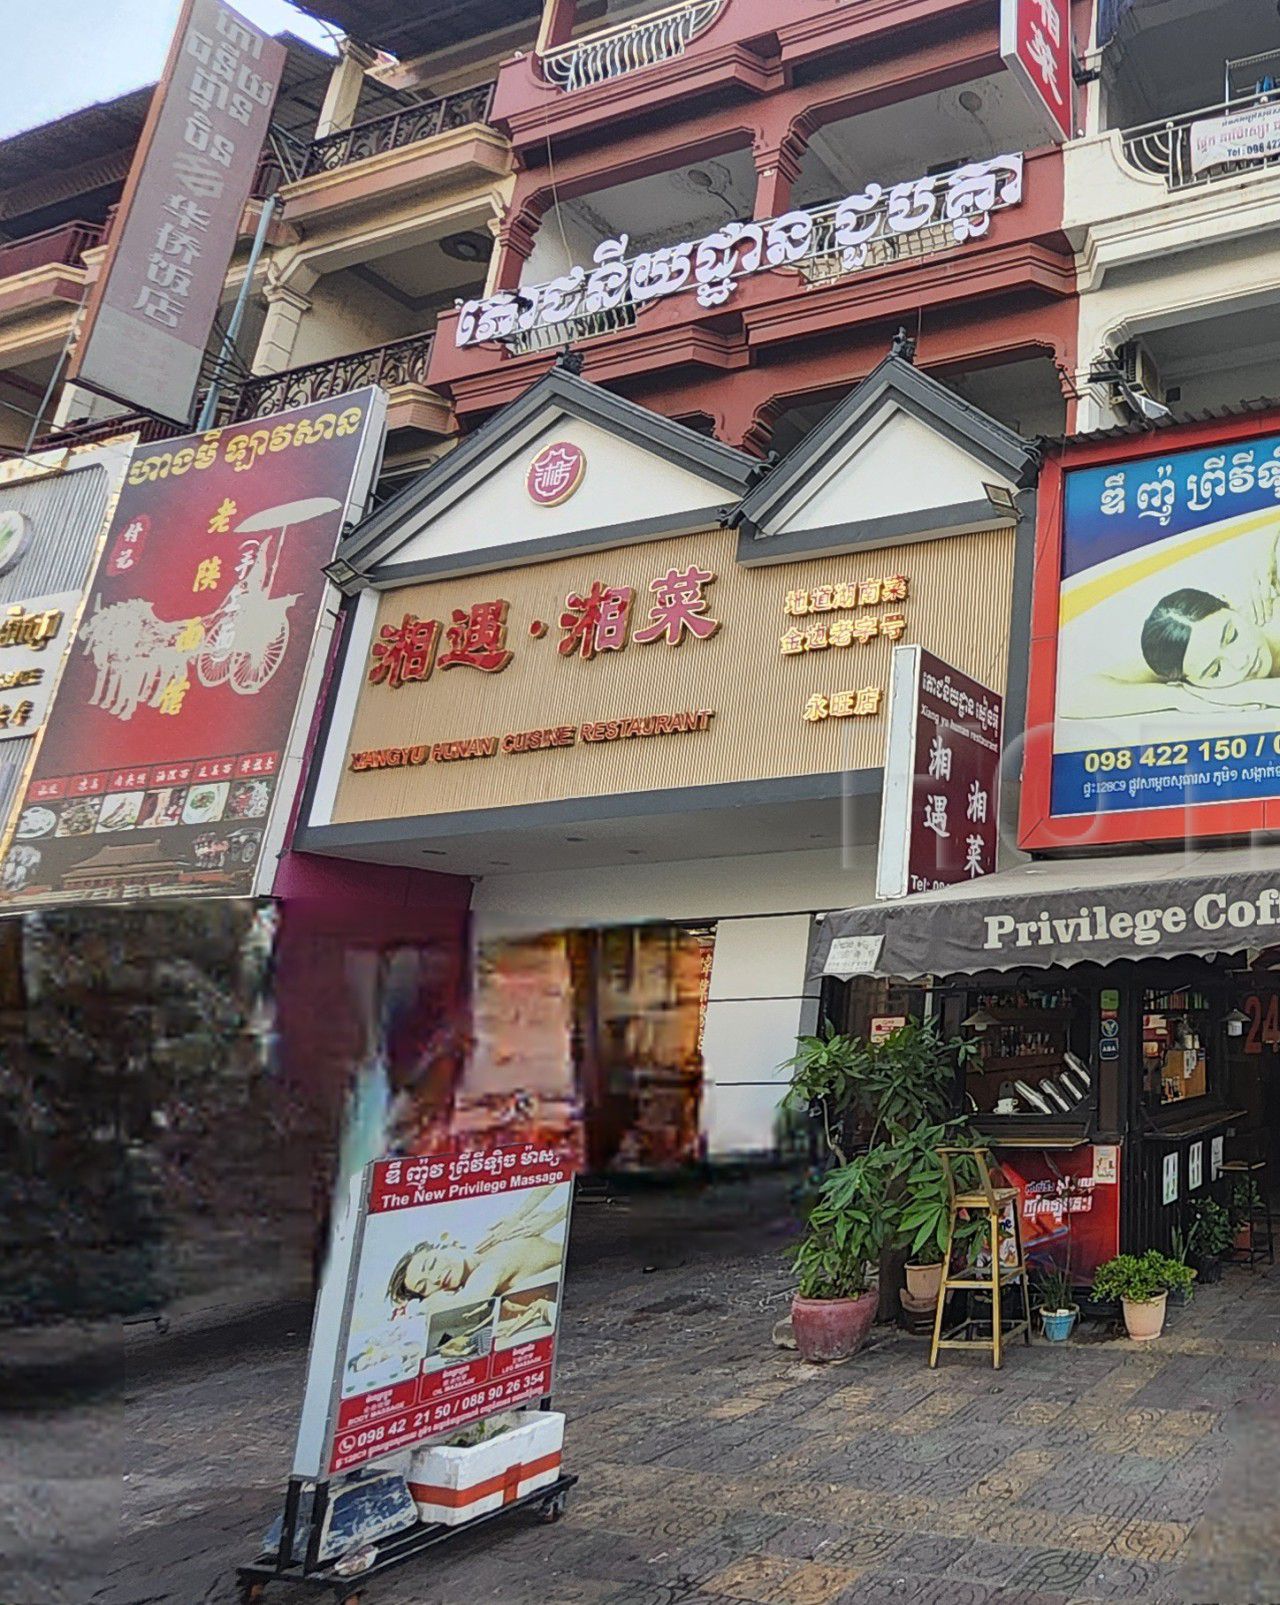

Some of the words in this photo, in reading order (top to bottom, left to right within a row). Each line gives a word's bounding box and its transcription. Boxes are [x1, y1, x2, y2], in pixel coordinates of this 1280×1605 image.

[133, 194, 212, 329] 华侨饭店
[784, 574, 911, 616] 地道湖南菜
[779, 612, 908, 656] 金边老字号
[802, 685, 884, 722] 永旺店
[348, 744, 427, 773] XIANGYU
[432, 736, 499, 764] HUNAN
[502, 724, 577, 755] CUISINE
[578, 708, 717, 745] RESTAURANT
[1084, 752, 1133, 774] 098
[1139, 744, 1189, 767] 422
[1198, 738, 1247, 762] 150
[923, 734, 952, 838] 湘遇
[963, 779, 988, 878] 湘菜
[910, 874, 930, 892] Tel:
[982, 904, 1188, 949] Privilege
[381, 1195, 409, 1209] The
[412, 1188, 447, 1204] New
[448, 1177, 508, 1198] Privilege
[509, 1169, 565, 1189] Massage
[357, 1429, 385, 1448] 098
[388, 1420, 406, 1436] 42
[413, 1412, 430, 1428] 21
[434, 1402, 451, 1420] 50
[461, 1391, 485, 1411] 088
[487, 1385, 503, 1401] 90
[505, 1378, 521, 1396] 26
[523, 1370, 545, 1387] 354
